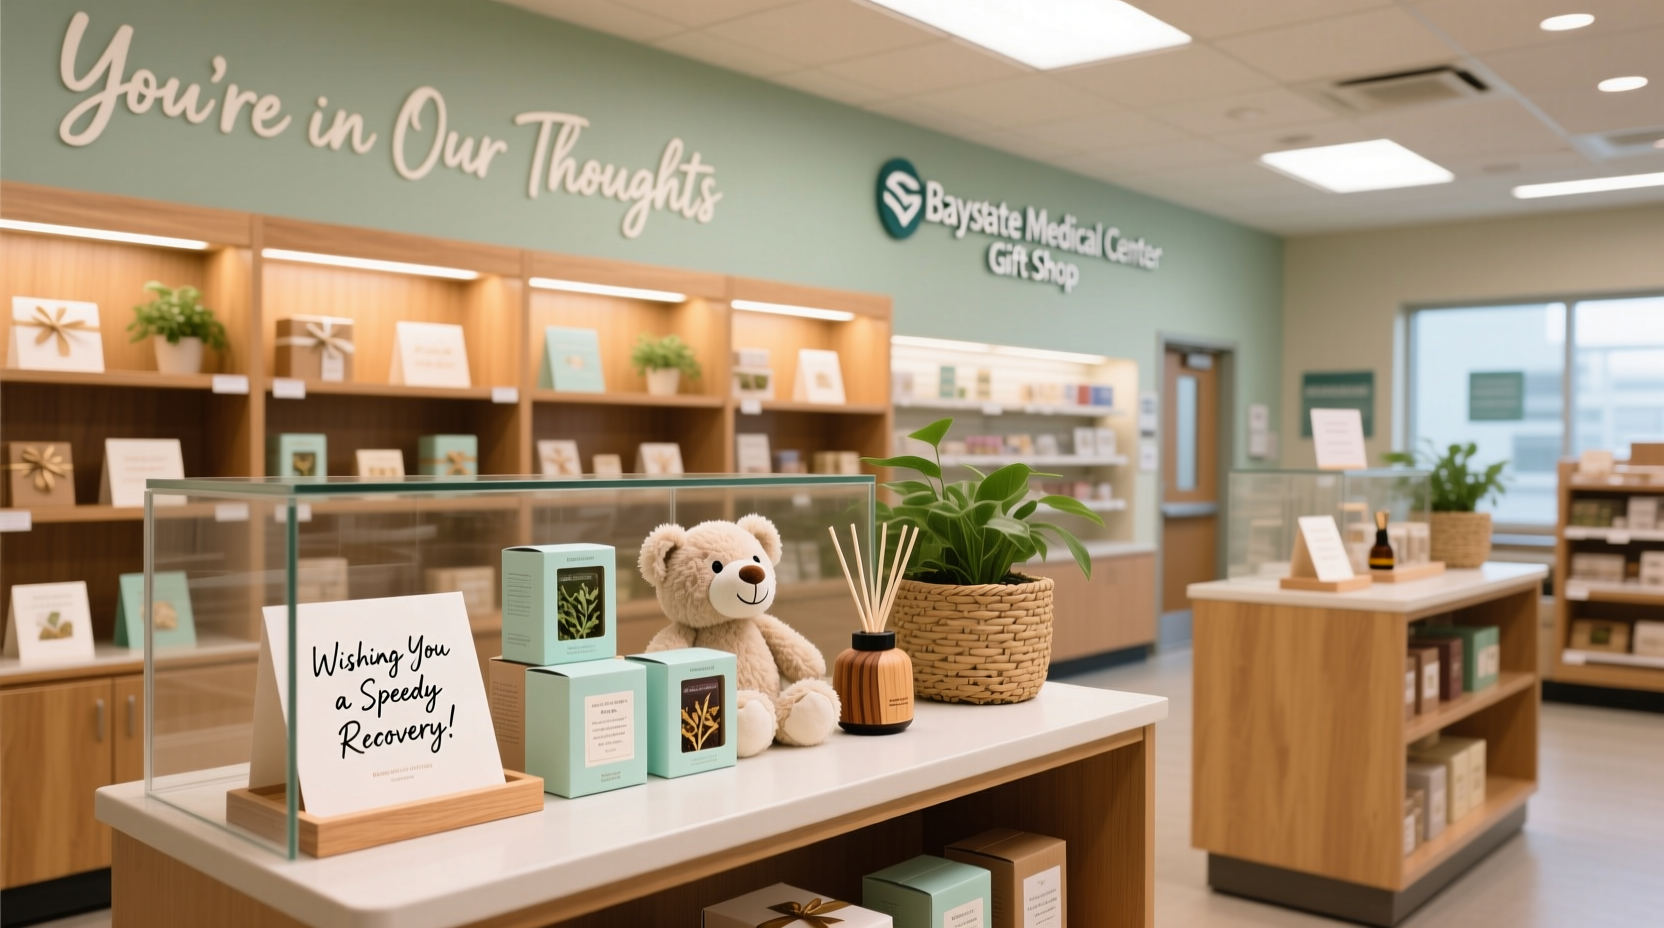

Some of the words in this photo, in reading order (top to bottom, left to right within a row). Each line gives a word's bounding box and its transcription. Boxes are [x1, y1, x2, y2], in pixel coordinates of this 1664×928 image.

[59, 11, 292, 146] You're
[308, 95, 377, 154] in
[392, 86, 507, 180] Our
[514, 111, 723, 239] Thoughts
[925, 180, 1023, 239] Baystate
[1025, 205, 1103, 257] Medical
[1104, 226, 1163, 270] Center
[988, 241, 1029, 279] Gift
[1031, 248, 1080, 294] Shop
[312, 640, 404, 679] Wishing
[408, 634, 451, 672] You
[335, 695, 353, 710] a
[360, 673, 443, 719] Speedy
[338, 704, 456, 760] Recovery!
